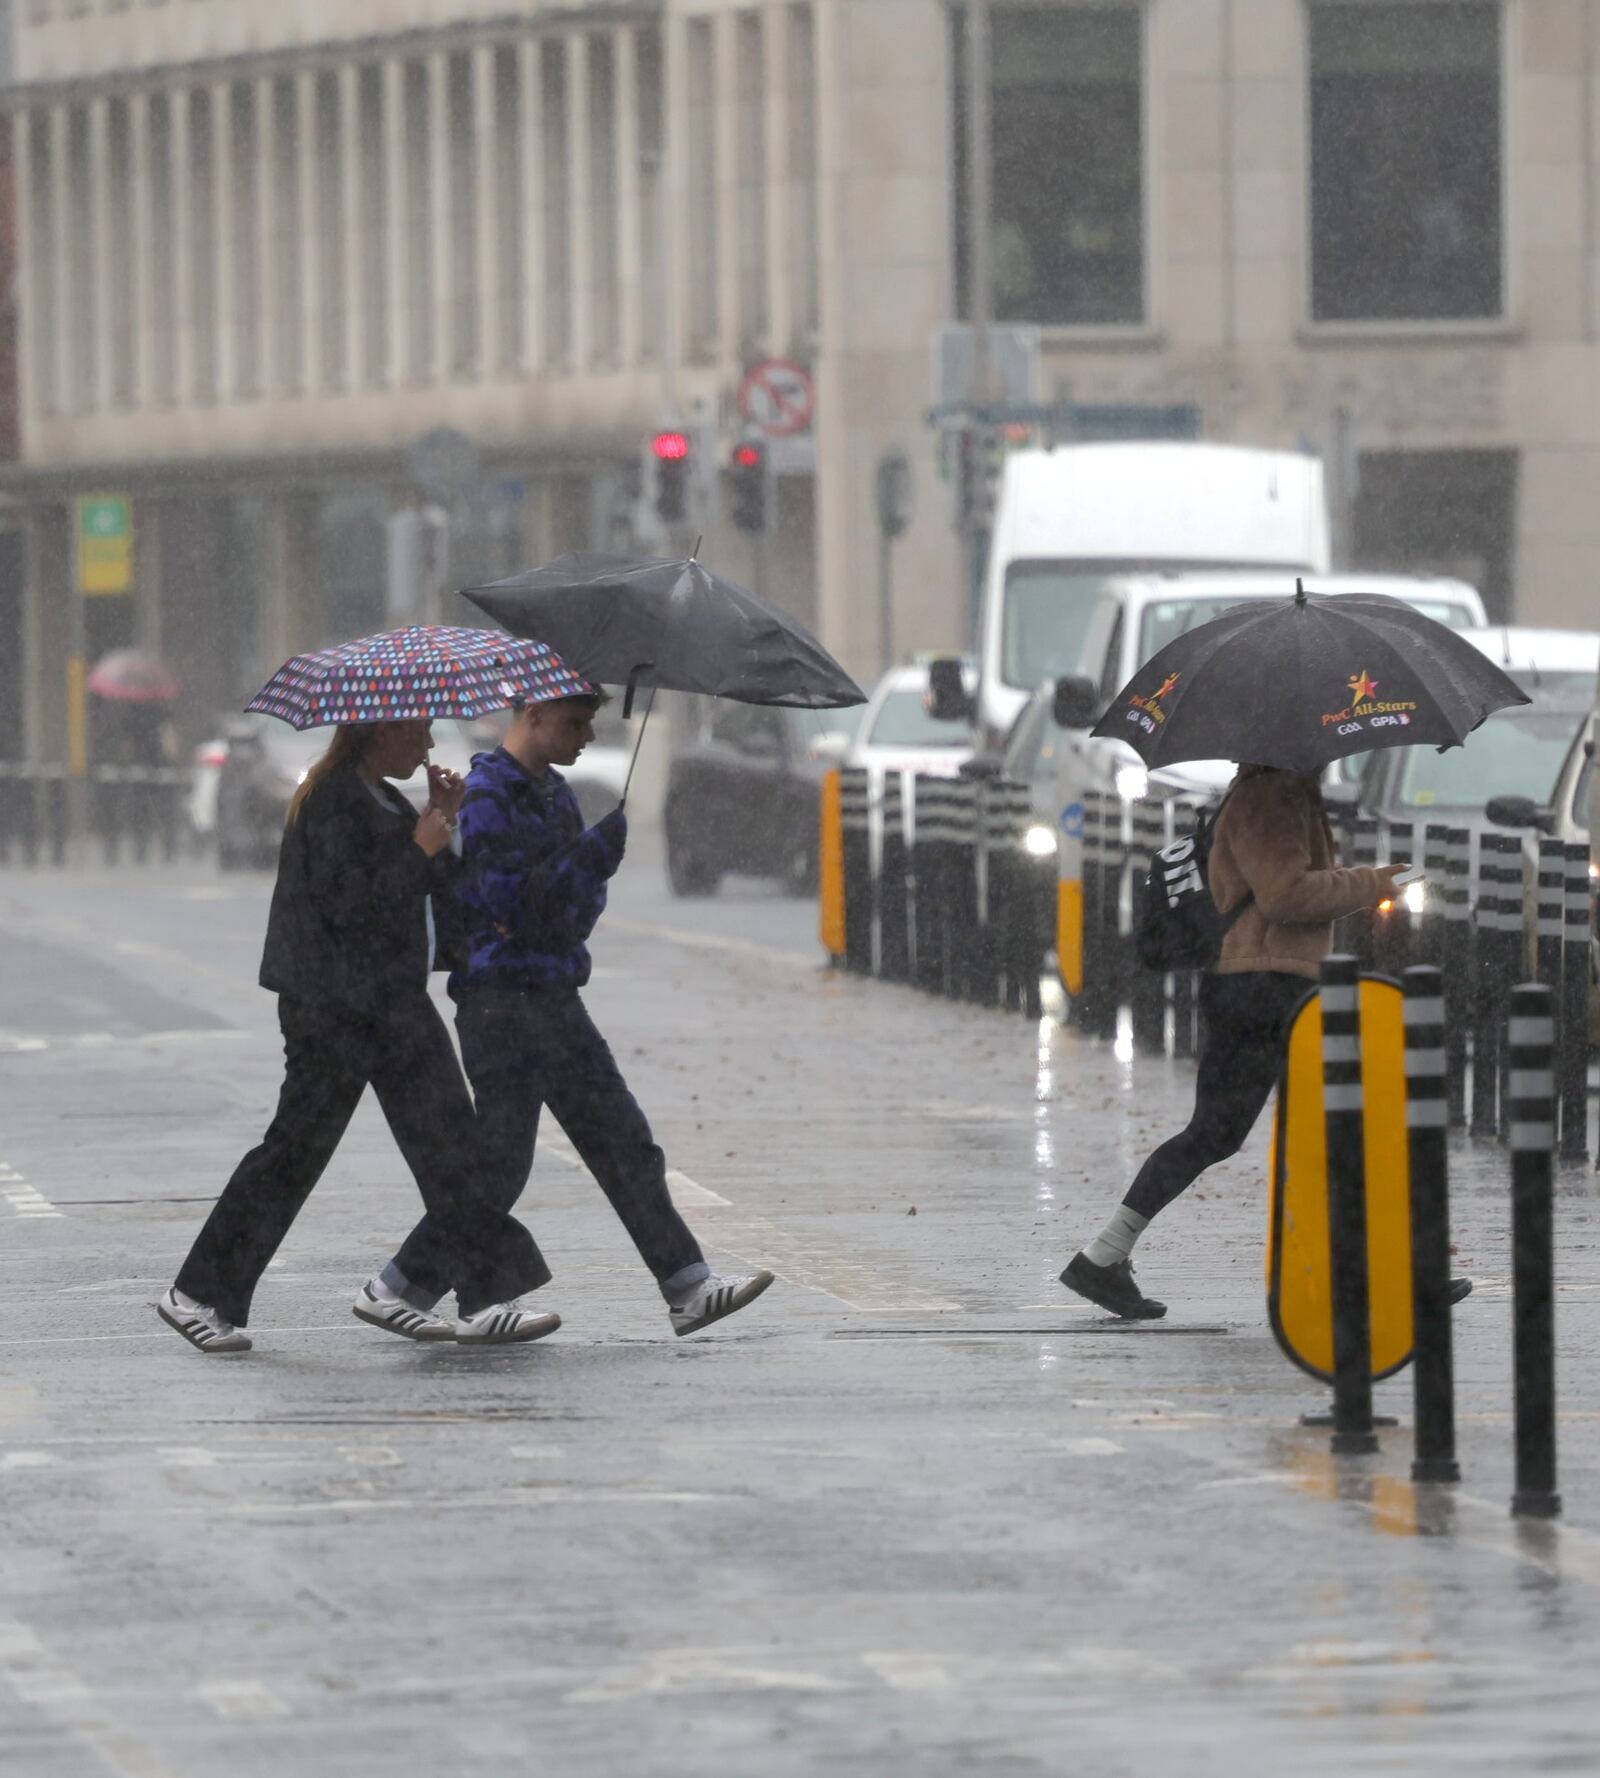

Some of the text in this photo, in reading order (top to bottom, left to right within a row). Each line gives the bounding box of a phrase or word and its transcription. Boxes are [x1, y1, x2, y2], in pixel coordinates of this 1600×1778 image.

[1321, 702, 1417, 727] PwC All-Stars
[1371, 715, 1399, 727] GPA
